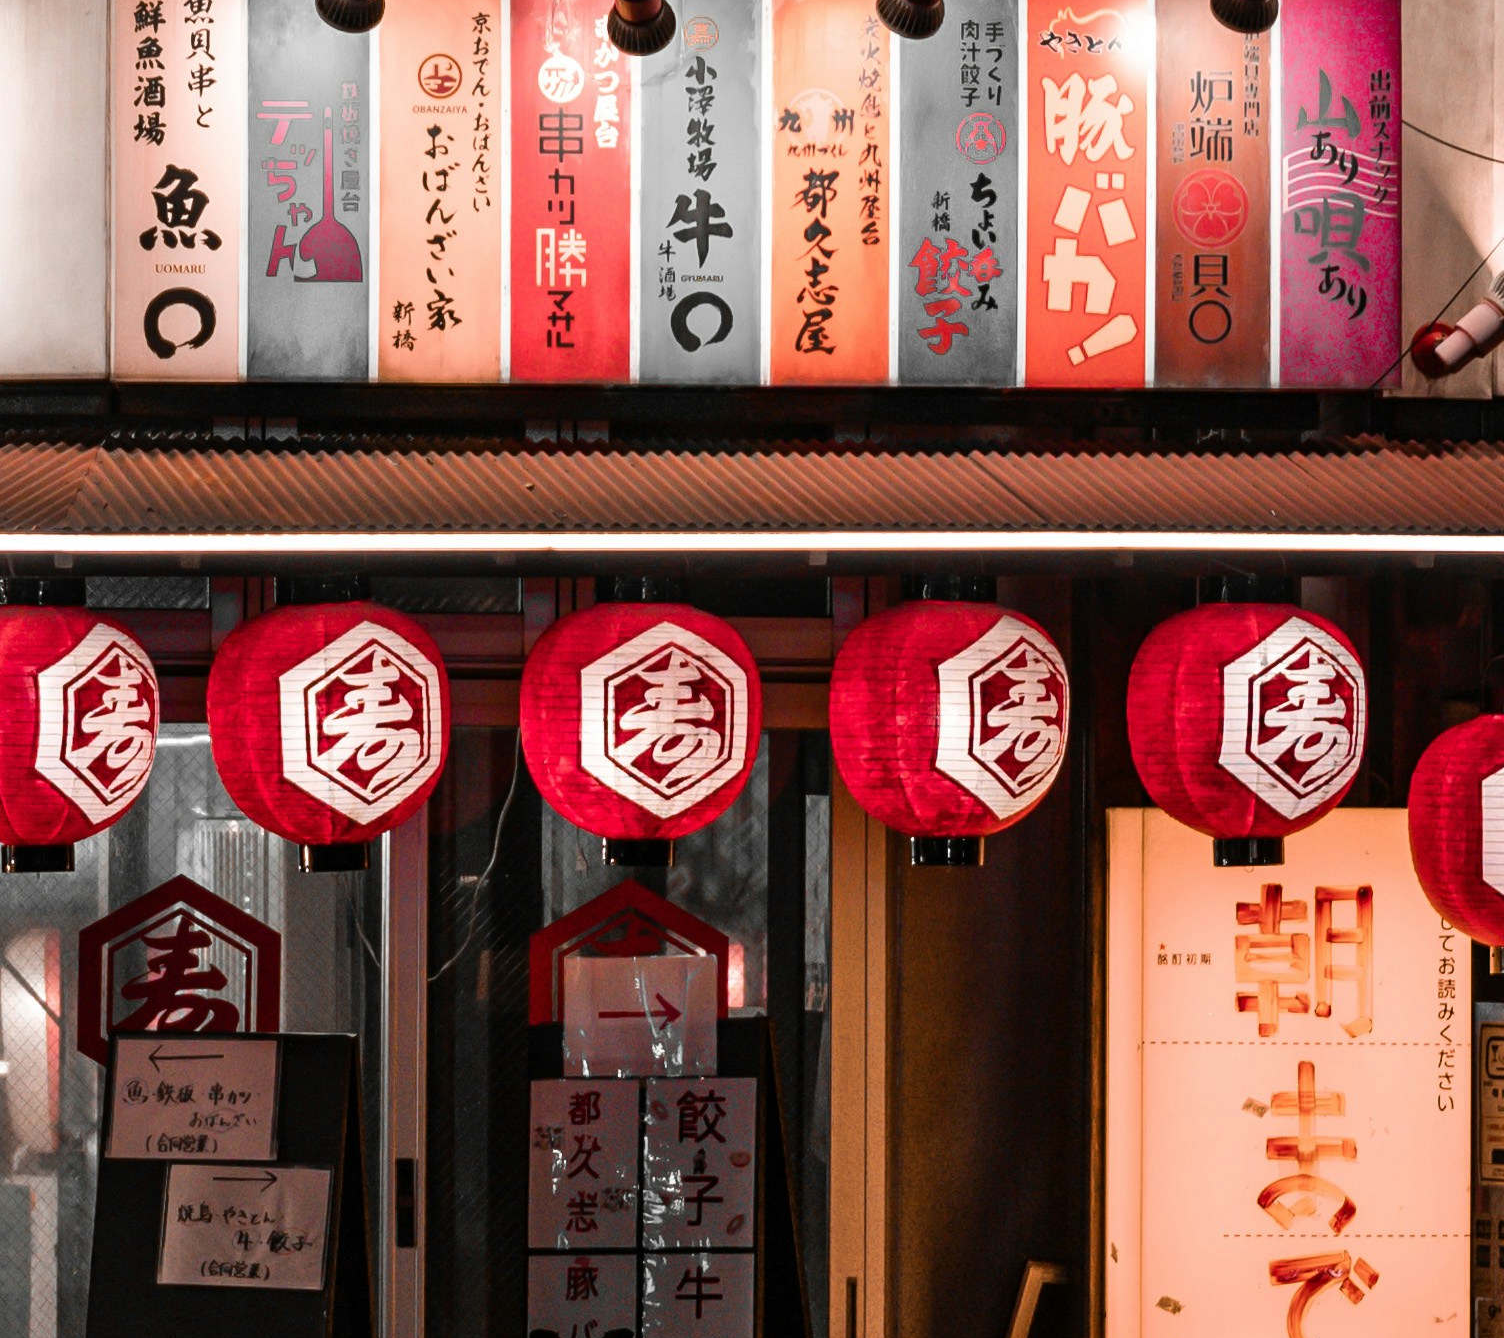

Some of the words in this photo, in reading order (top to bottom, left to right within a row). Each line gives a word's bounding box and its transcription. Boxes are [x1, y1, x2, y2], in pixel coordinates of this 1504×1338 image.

[133, 0, 167, 147] 鮮魚酒場
[412, 104, 468, 114] OBANZAIYA
[685, 55, 717, 181] 小澤牧場
[959, 20, 981, 109] 肉汁餃子
[985, 21, 1004, 108] 手づくり
[1189, 69, 1234, 163] 炉端
[1369, 68, 1396, 207] 出前スナック
[423, 123, 463, 332] おばんざい家
[794, 167, 839, 355] 都久志屋
[930, 191, 952, 234] 新橋
[1041, 73, 1139, 367] 豚バカ!
[155, 263, 206, 275] UOMARU
[657, 240, 677, 302] 牛酒場
[910, 236, 973, 356] 餃子
[392, 301, 417, 352] 新橋
[676, 1089, 727, 1228] 餃子
